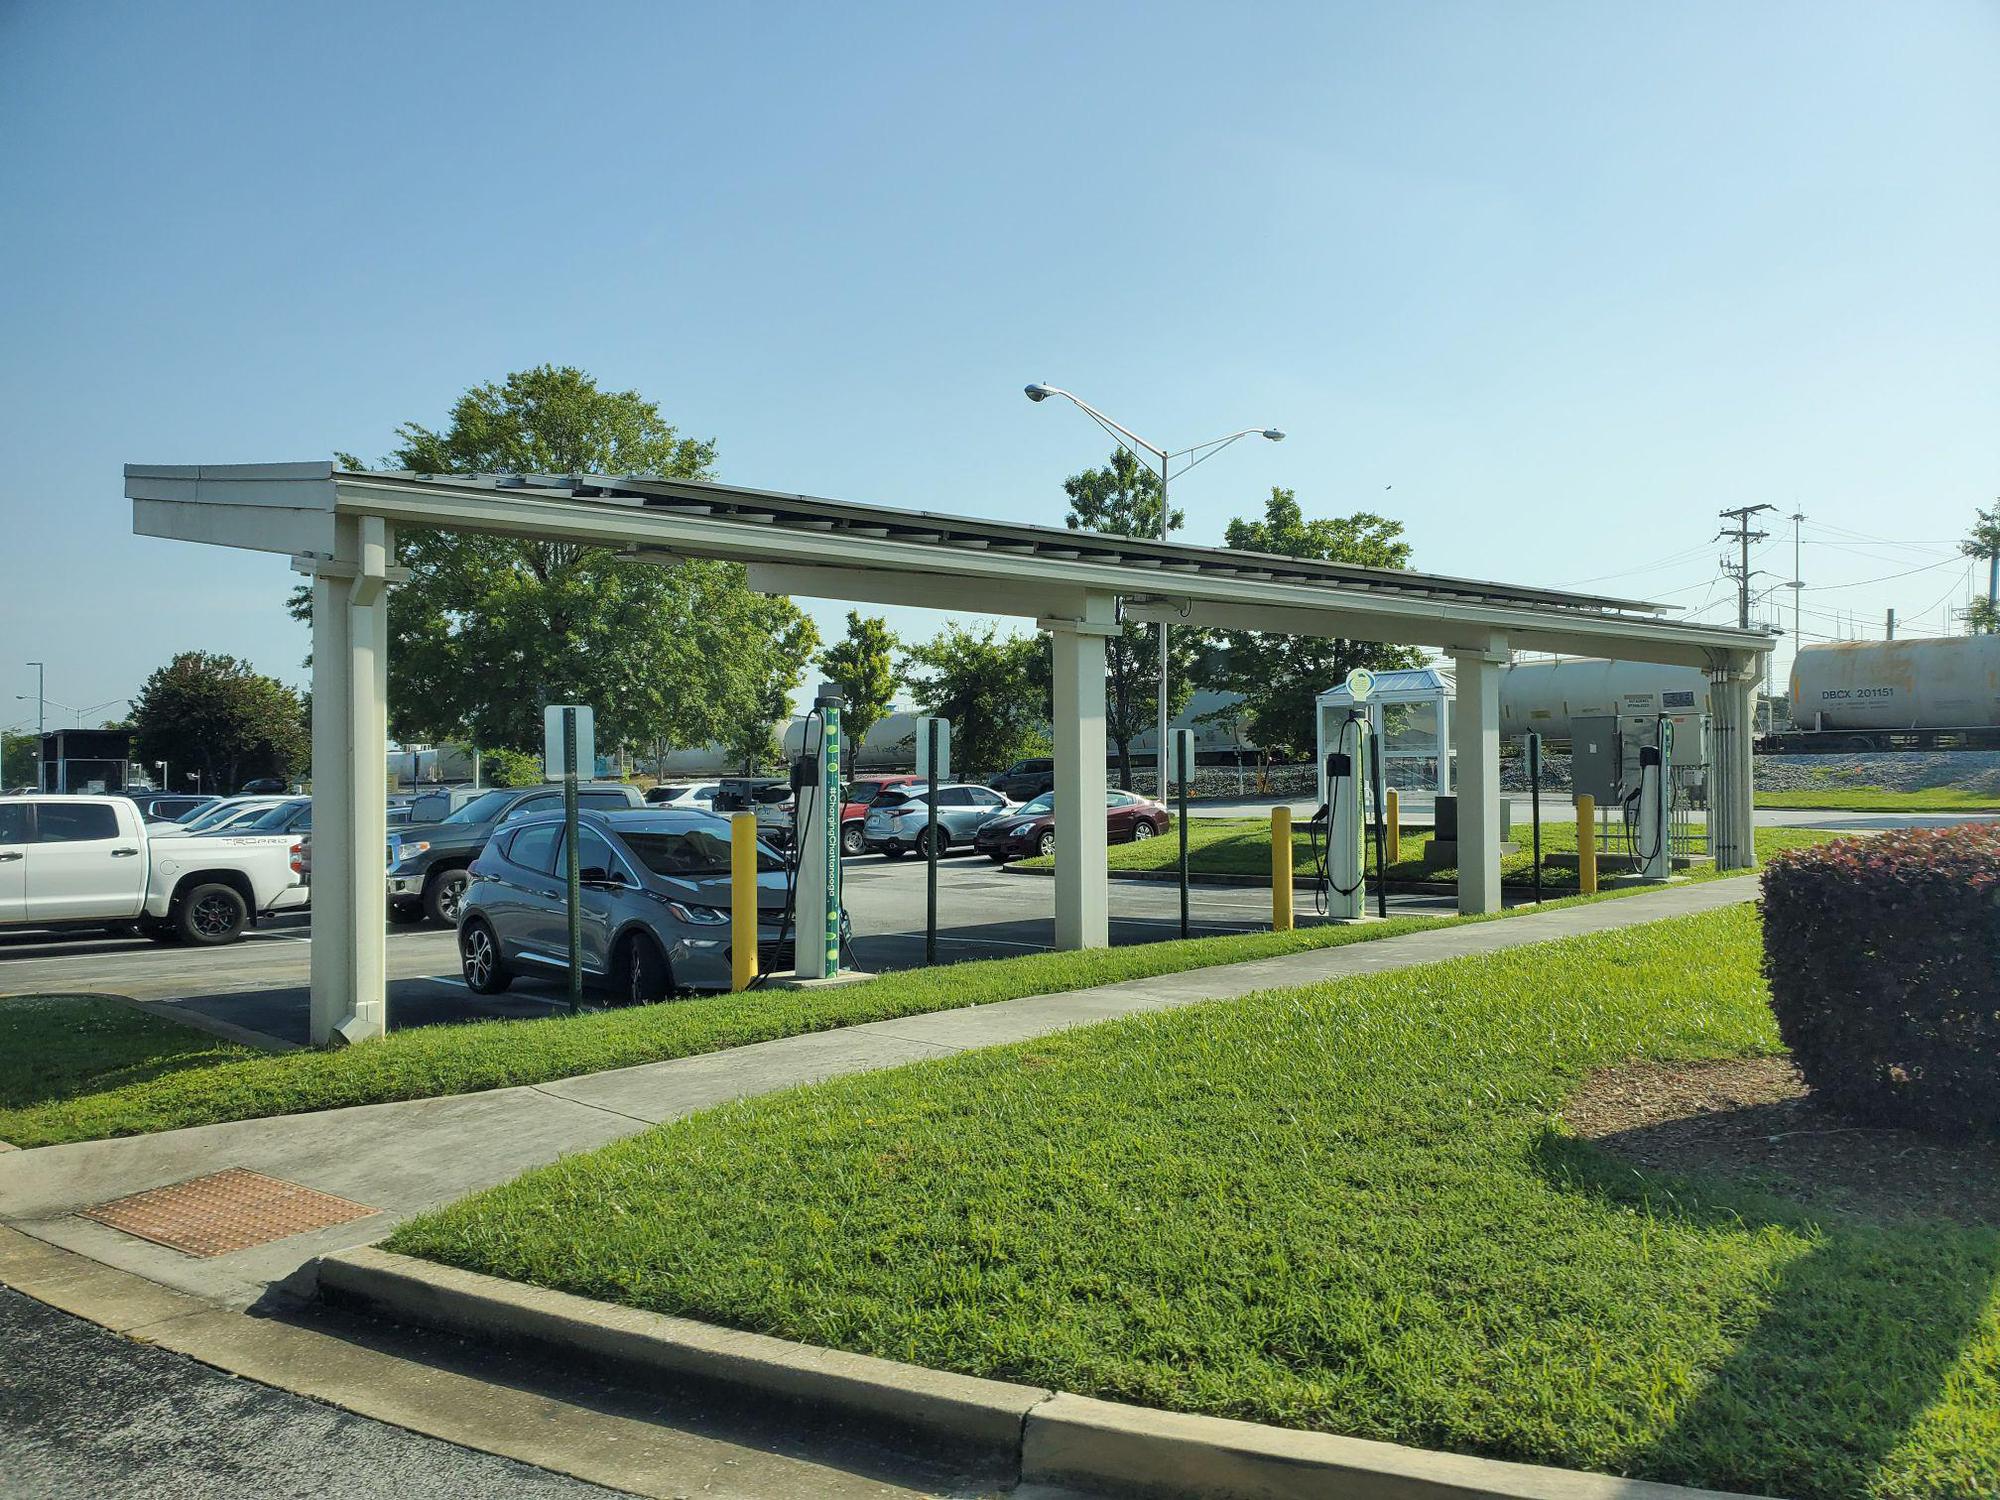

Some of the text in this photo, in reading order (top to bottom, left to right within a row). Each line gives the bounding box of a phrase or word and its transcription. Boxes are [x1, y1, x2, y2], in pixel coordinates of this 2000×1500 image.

[1822, 688, 1894, 700] DBCX 201151
[827, 786, 838, 897] #ChargingChattanooga
